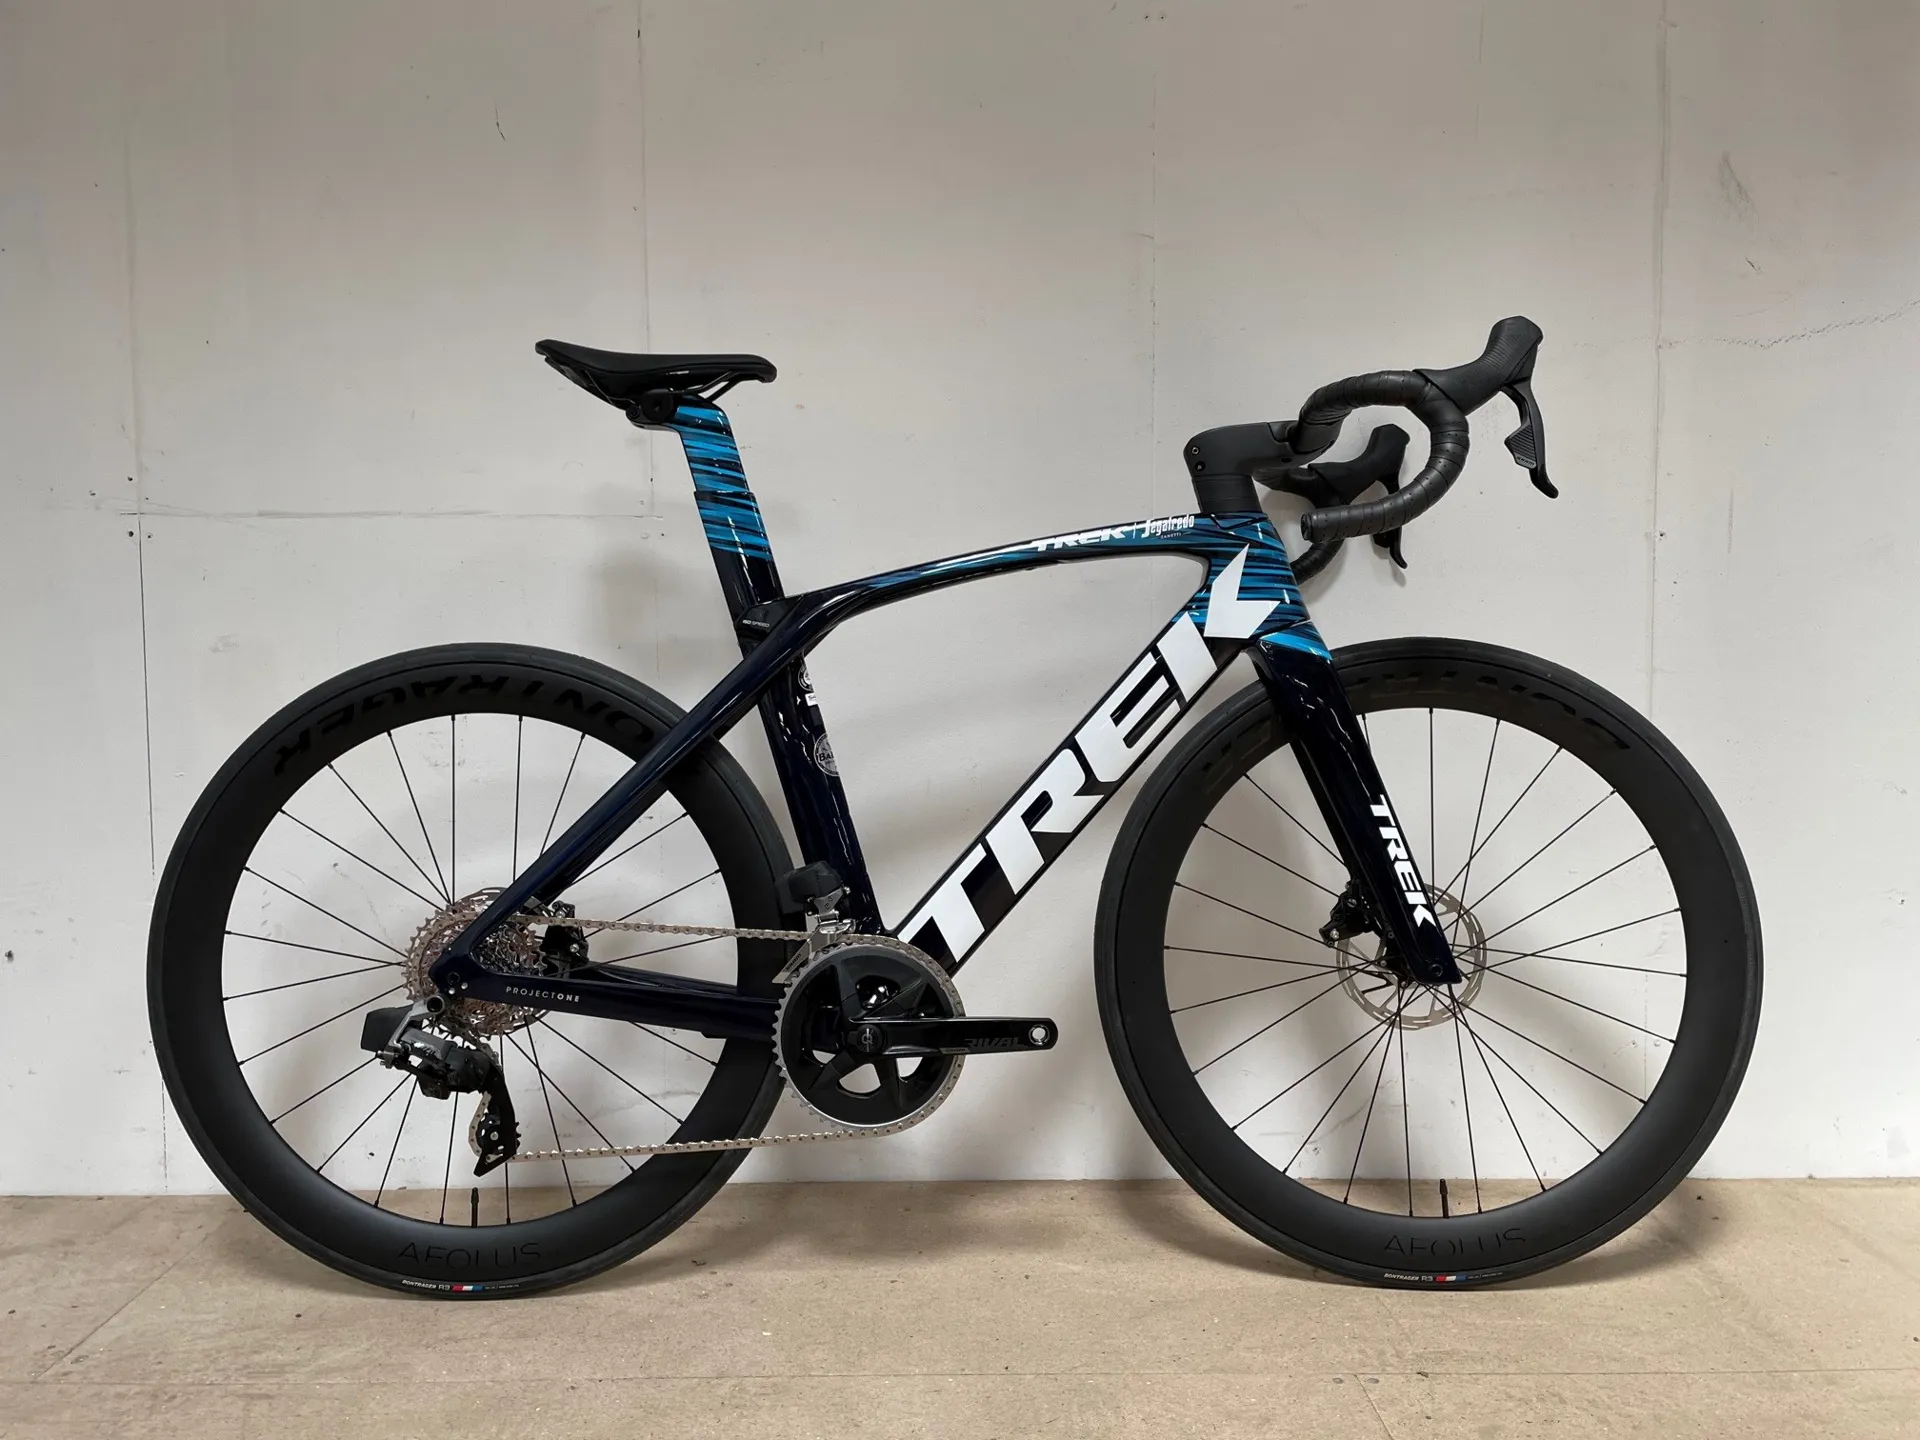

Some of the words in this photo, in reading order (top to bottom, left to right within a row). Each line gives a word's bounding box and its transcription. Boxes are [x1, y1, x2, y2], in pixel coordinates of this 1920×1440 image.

[1029, 525, 1130, 551] TREK
[274, 674, 655, 777] ONTRAGER
[897, 543, 1281, 963] TREK
[1370, 794, 1436, 928] TREK
[401, 1279, 437, 1290] BONTRAGER
[1383, 1272, 1420, 1281] BONTRAGER
